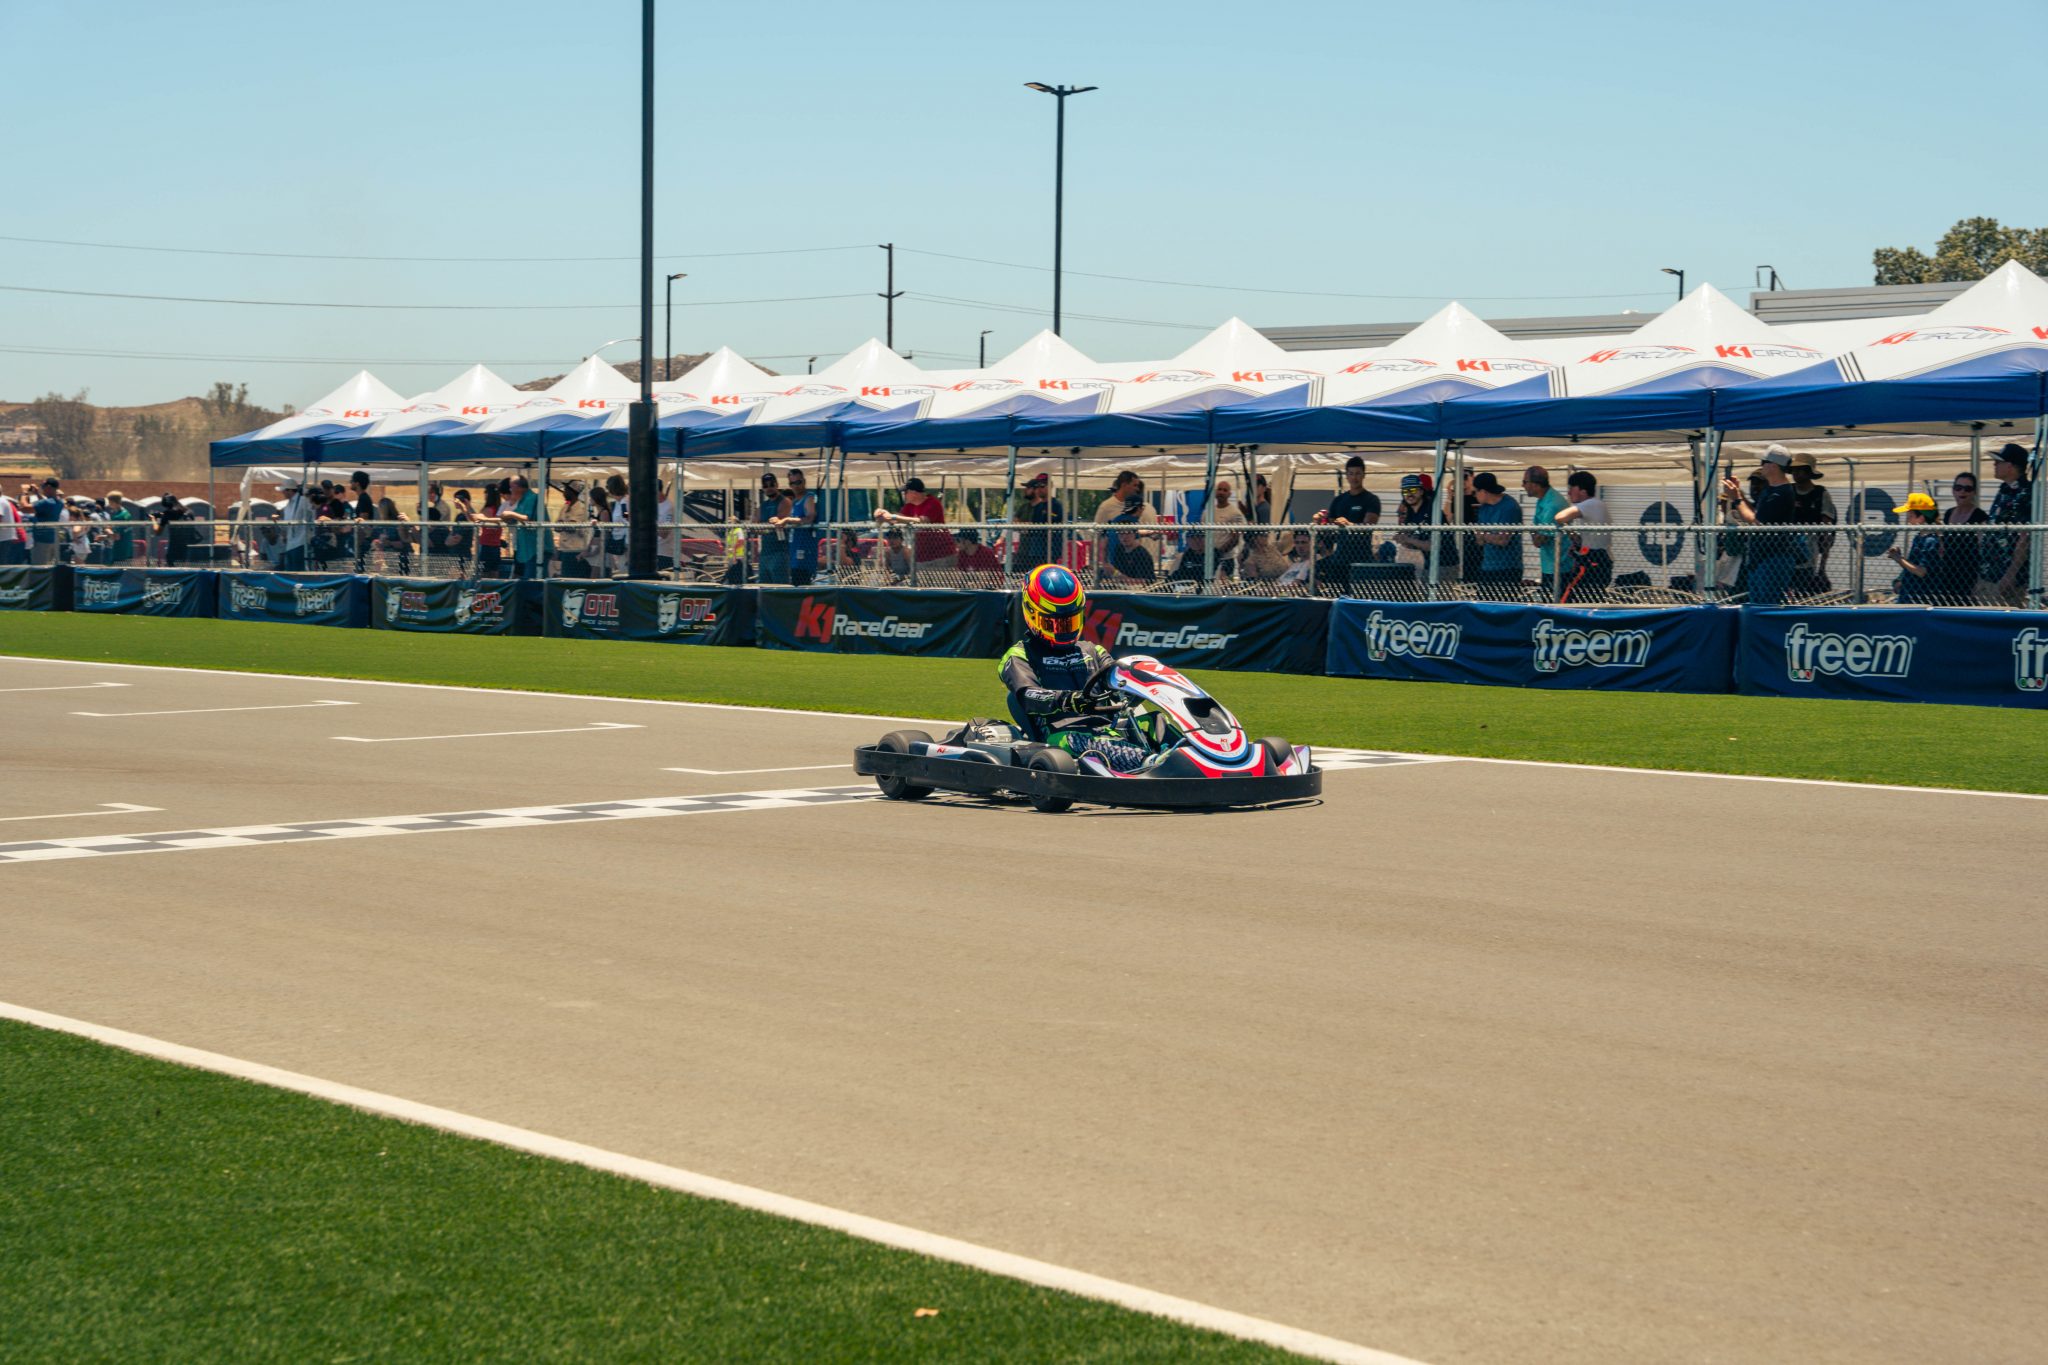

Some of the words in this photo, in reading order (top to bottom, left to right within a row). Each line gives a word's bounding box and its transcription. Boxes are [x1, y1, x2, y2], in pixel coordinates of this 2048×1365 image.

[584, 593, 619, 617] OTL
[679, 598, 716, 621] OTL
[1366, 611, 1459, 660] freem
[1533, 620, 1650, 671] freem
[1785, 624, 1912, 680] freem
